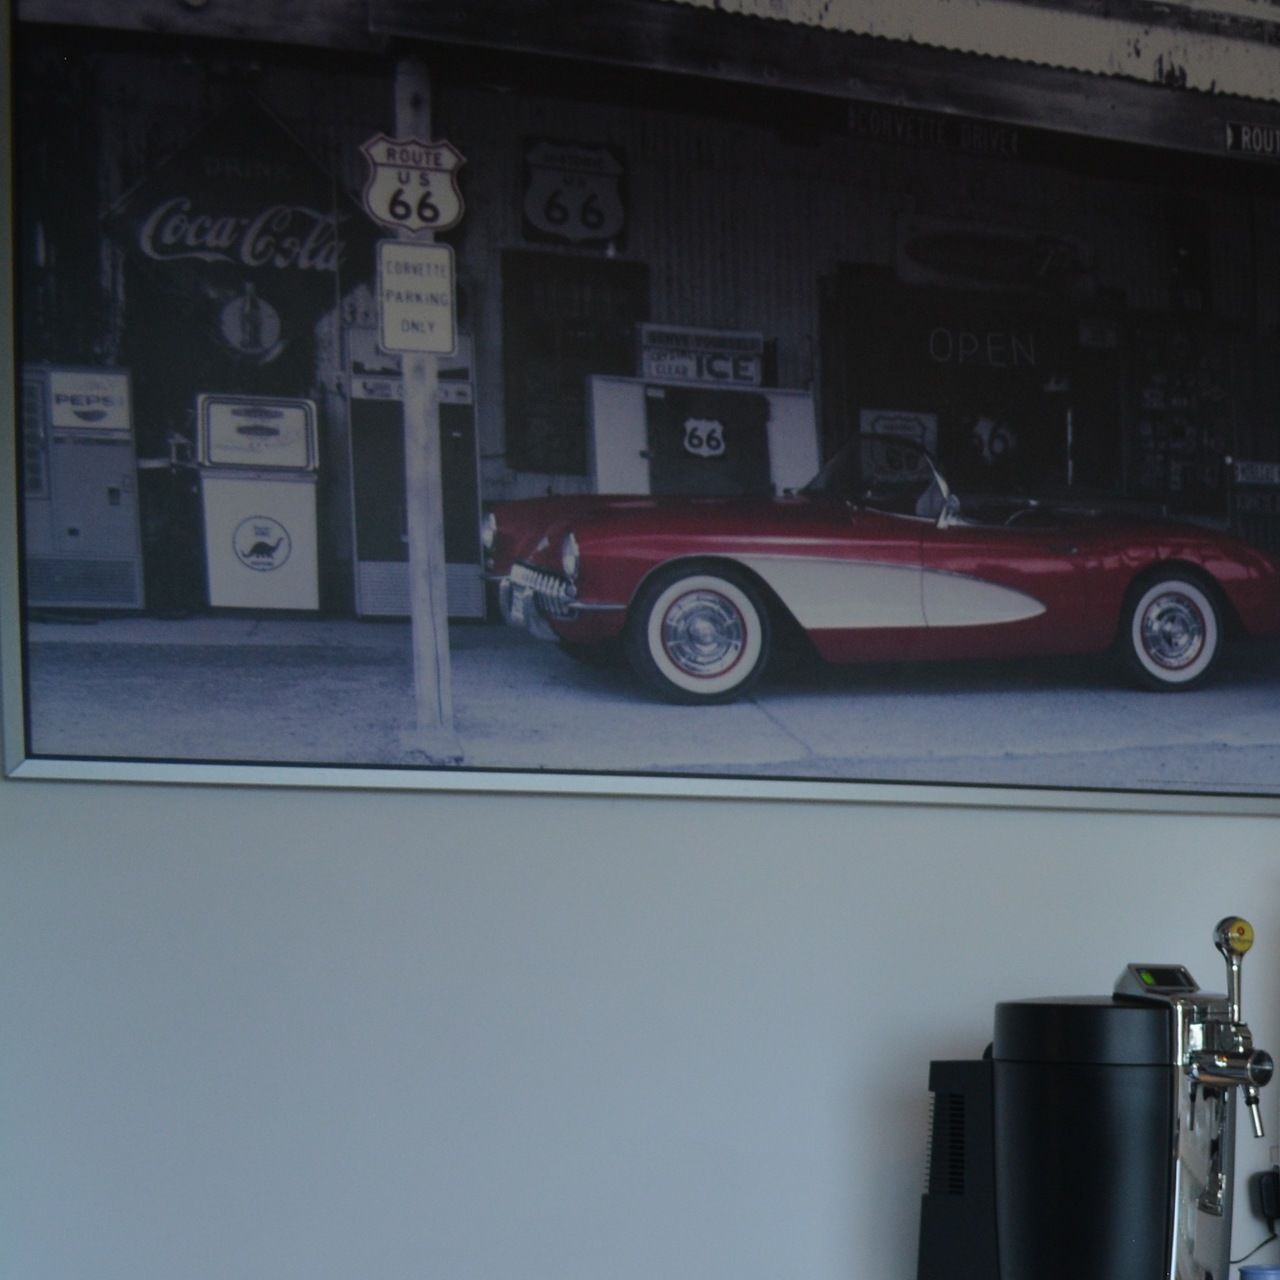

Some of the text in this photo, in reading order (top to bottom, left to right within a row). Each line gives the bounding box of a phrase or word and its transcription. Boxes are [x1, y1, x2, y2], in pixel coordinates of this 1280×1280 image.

[386, 148, 443, 167] ROUTE
[389, 189, 440, 223] 66
[544, 190, 604, 229] 66
[140, 197, 348, 272] Coca-Cola
[386, 260, 446, 278] CORVETTE
[385, 289, 448, 306] PARKING
[401, 319, 434, 333] ONLY
[929, 327, 1036, 367] OPEN
[696, 351, 754, 381] ICE
[688, 427, 721, 449] 66
